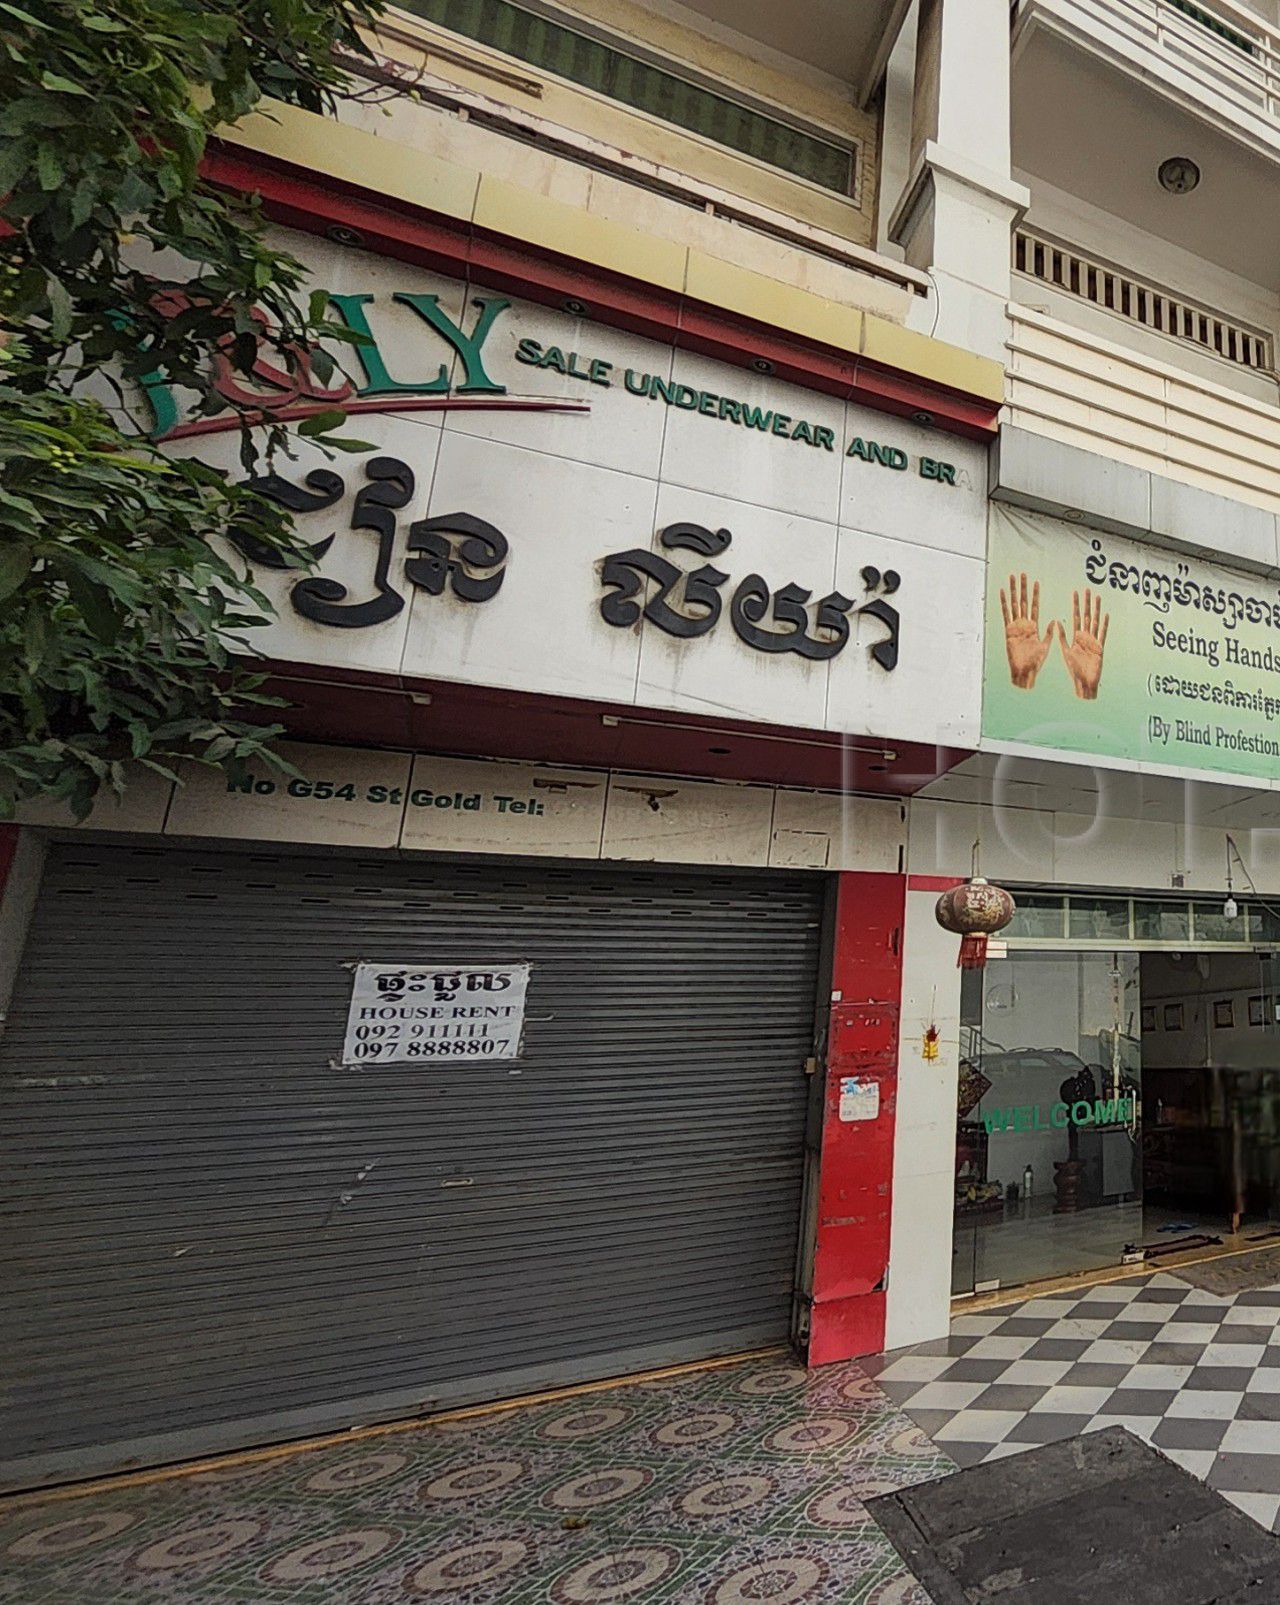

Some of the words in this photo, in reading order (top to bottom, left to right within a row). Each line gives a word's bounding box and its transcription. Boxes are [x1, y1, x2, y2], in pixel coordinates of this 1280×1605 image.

[515, 337, 613, 386] SALE
[624, 367, 835, 452] UNDERWEAR
[847, 435, 908, 471] AND
[1152, 620, 1220, 667] Seeing
[1148, 715, 1171, 746] (By
[1176, 719, 1211, 745] Blind
[287, 779, 357, 802] G54
[366, 785, 402, 805] St
[411, 789, 482, 811] Gold
[493, 795, 545, 816] Tel:
[359, 1007, 444, 1020] HOUSE
[451, 1006, 517, 1019] RENT
[355, 1024, 401, 1040] 092
[411, 1023, 489, 1039] 911111
[354, 1042, 399, 1059] 097
[407, 1039, 510, 1057] 8888807
[982, 1097, 1133, 1135] WELCOME
